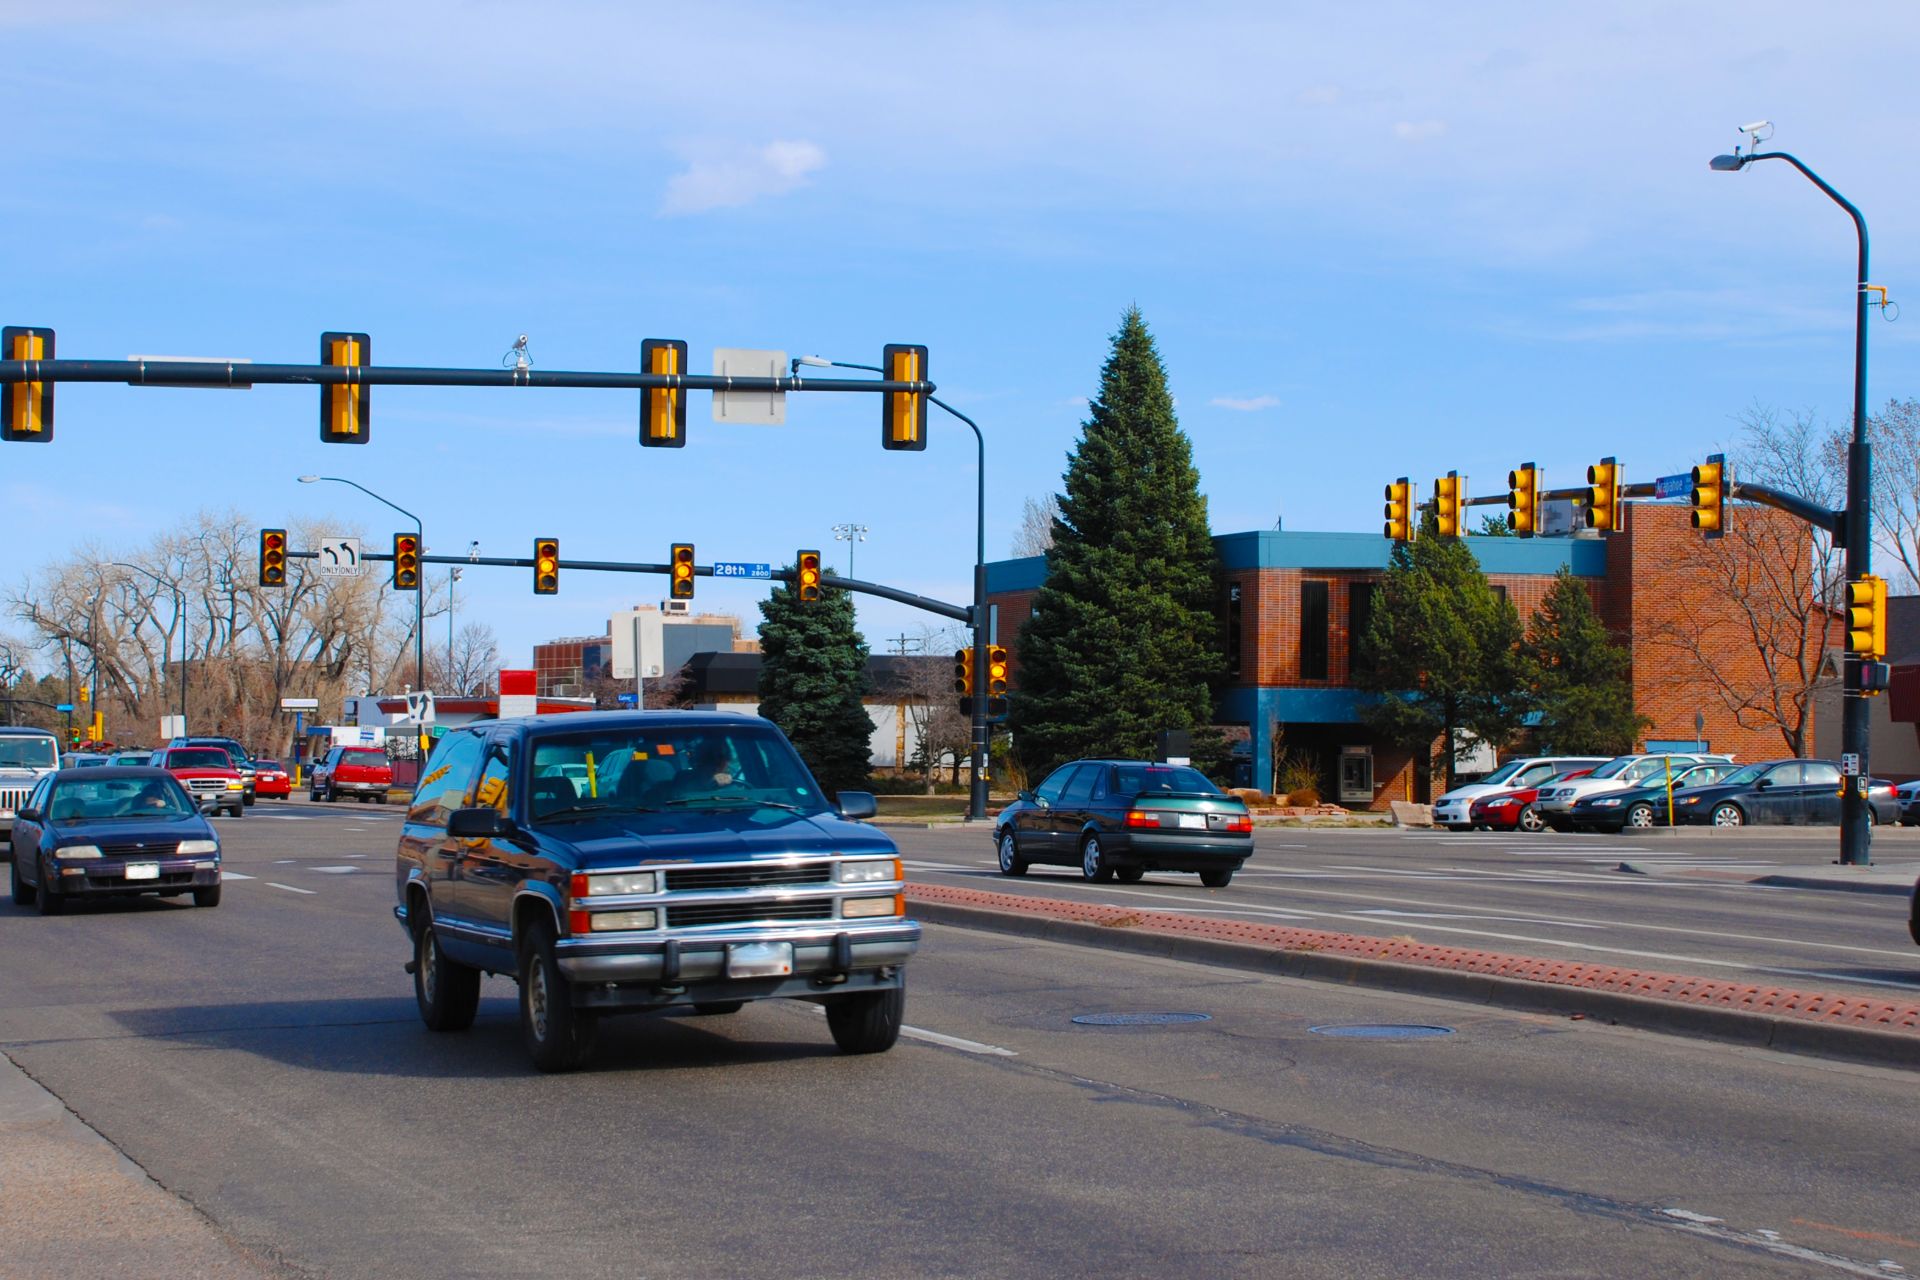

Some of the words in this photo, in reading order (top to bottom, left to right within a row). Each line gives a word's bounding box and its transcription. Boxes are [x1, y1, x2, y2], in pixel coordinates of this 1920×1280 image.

[321, 566, 339, 575] ONLY
[340, 566, 358, 575] ONLY
[716, 564, 746, 576] 28th
